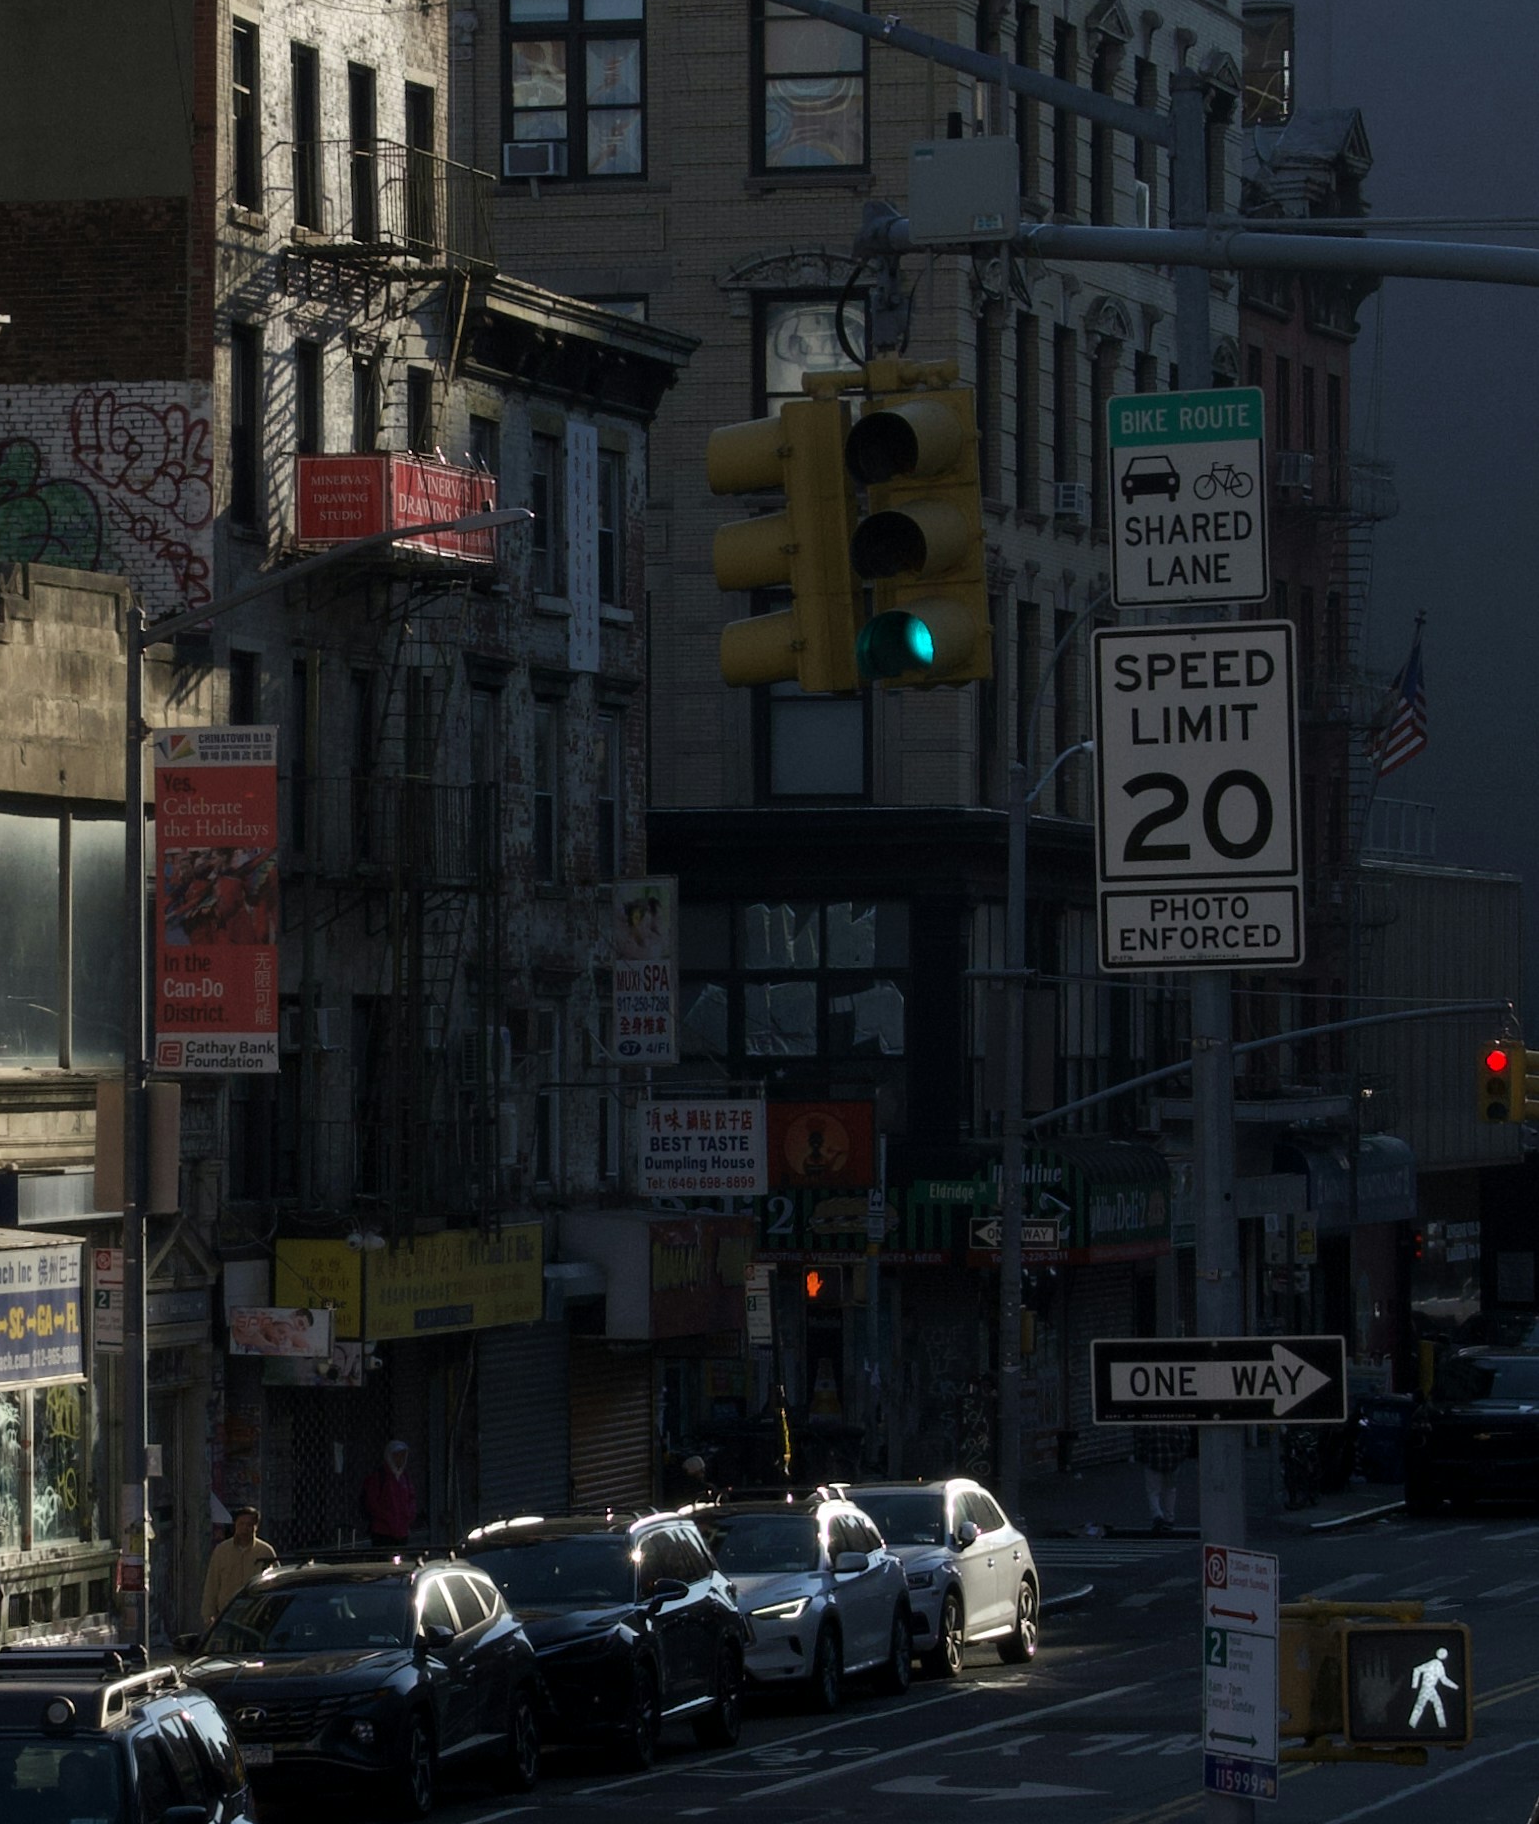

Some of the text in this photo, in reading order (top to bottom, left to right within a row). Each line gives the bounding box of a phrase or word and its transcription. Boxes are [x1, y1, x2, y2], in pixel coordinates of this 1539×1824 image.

[1120, 403, 1250, 434] BIKE ROUTE
[311, 475, 370, 486] MINERVA'S
[313, 492, 368, 504] DRAWING
[398, 492, 451, 522] DRAWING
[320, 510, 362, 521] STUDIO
[1125, 510, 1253, 547] SHARED
[1147, 552, 1231, 587] LANE
[1114, 648, 1274, 692] SPEED
[1132, 703, 1258, 745] LIMIT
[199, 733, 251, 743] CHINATOWN
[163, 774, 196, 793] Yes,
[163, 797, 242, 816] Celebrate
[1123, 770, 1273, 862] 20
[163, 819, 269, 841] the Holidays
[1150, 897, 1248, 922] PHOTO
[1120, 924, 1281, 951] ENFORCED
[164, 954, 211, 972] In the
[644, 964, 669, 992] SPA
[163, 978, 223, 998] Can-Do
[163, 1004, 229, 1023] District.
[186, 1041, 274, 1057] Cathay Bank
[622, 1043, 637, 1054] 37
[186, 1054, 263, 1069] Foundation
[650, 1136, 749, 1151] BEST TASTE
[645, 1156, 755, 1173] Dumpling House
[646, 1176, 755, 1190] Tel: (646) 698-8899
[929, 1183, 974, 1202] Eldridge
[767, 1196, 795, 1234] 2
[1023, 1228, 1048, 1240] WAY
[914, 1251, 941, 1263] BEER
[18, 1261, 32, 1283] Inc
[98, 1292, 107, 1307] 2
[9, 1306, 24, 1340] SC
[37, 1304, 53, 1337] GA
[66, 1302, 79, 1334] FL
[1130, 1365, 1304, 1396] ONE WAY
[1210, 1631, 1222, 1663] 2
[1208, 1694, 1255, 1715] Except Sunday
